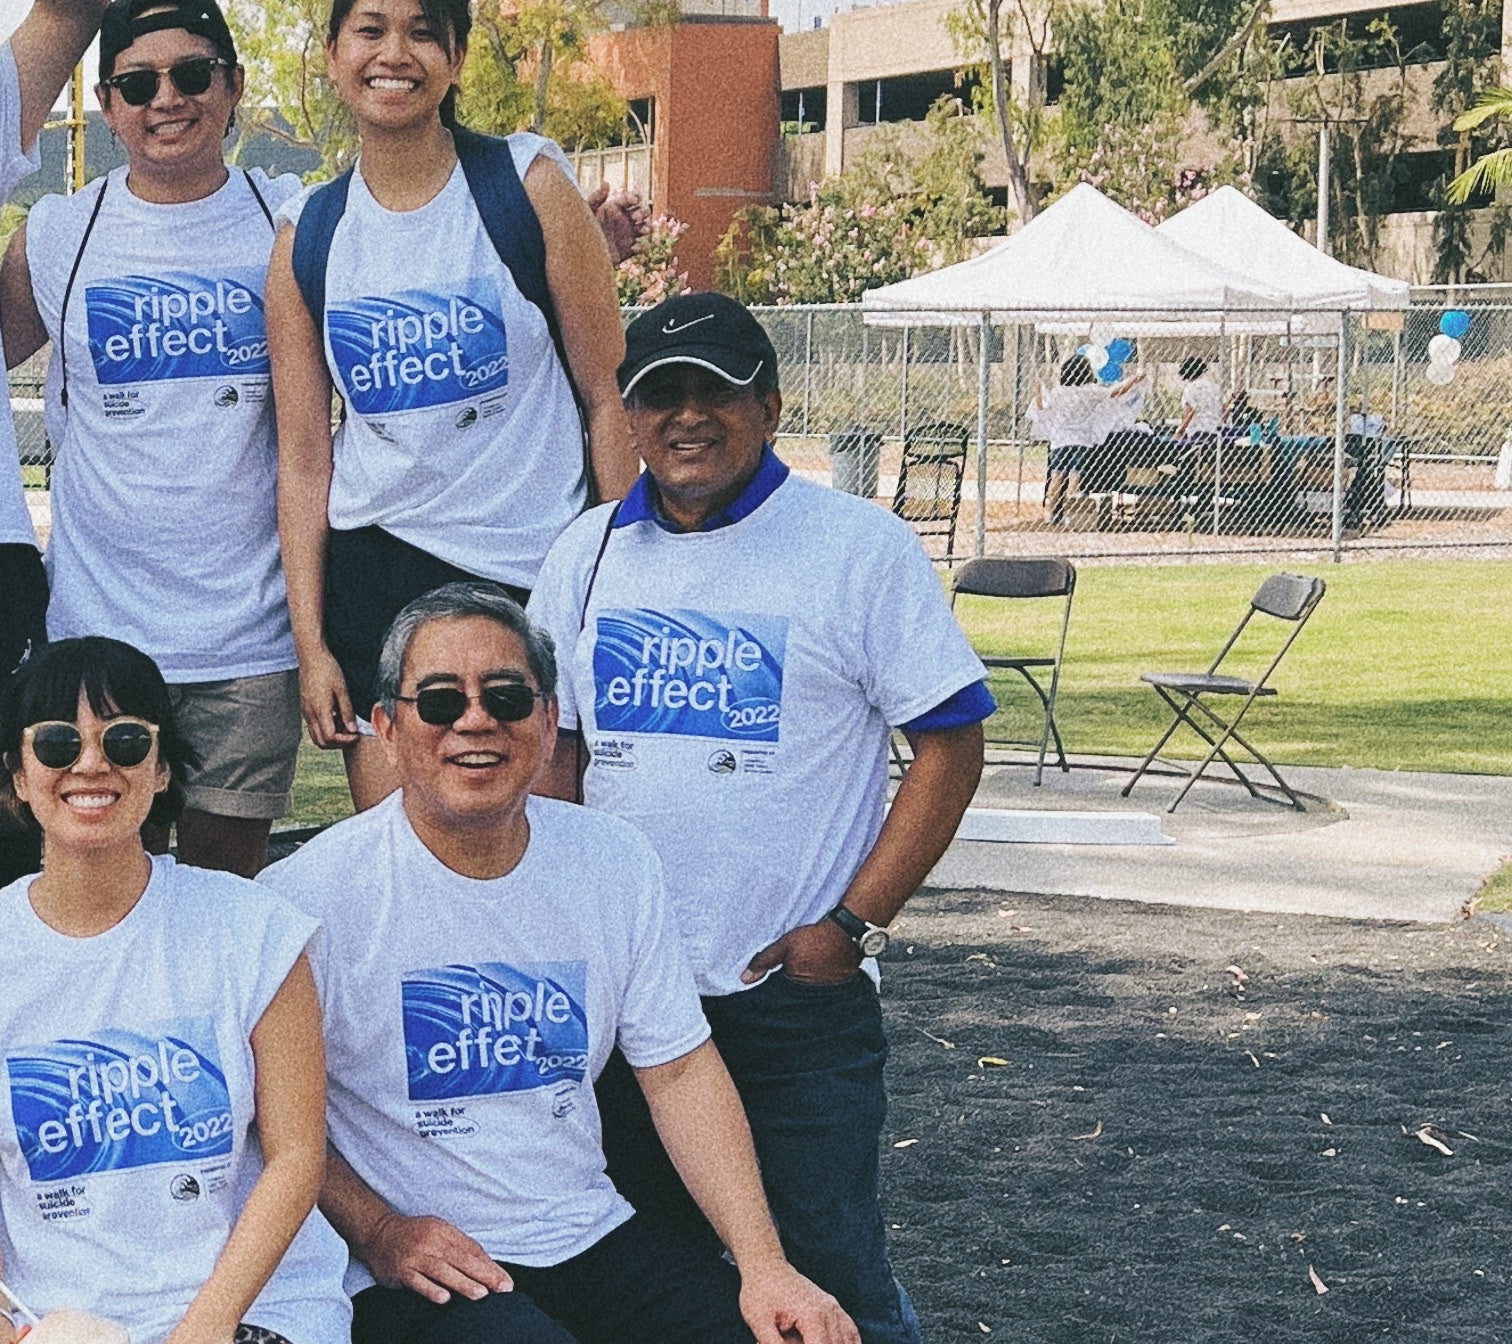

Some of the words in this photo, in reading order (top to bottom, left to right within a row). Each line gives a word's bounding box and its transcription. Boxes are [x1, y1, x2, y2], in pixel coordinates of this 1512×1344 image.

[134, 281, 252, 327] ripple
[371, 297, 484, 353] ripple
[105, 318, 229, 362] effect
[350, 341, 466, 392] effect
[465, 356, 509, 387] 2022
[641, 626, 762, 677] ripple
[607, 668, 732, 713] effect
[728, 704, 780, 729] 2022
[68, 1040, 200, 1105] ripple
[427, 1026, 543, 1075] effet
[535, 1054, 589, 1075] 2022
[38, 1090, 181, 1154] effect
[179, 1113, 233, 1148] 2022
[418, 1126, 475, 1138] prevention
